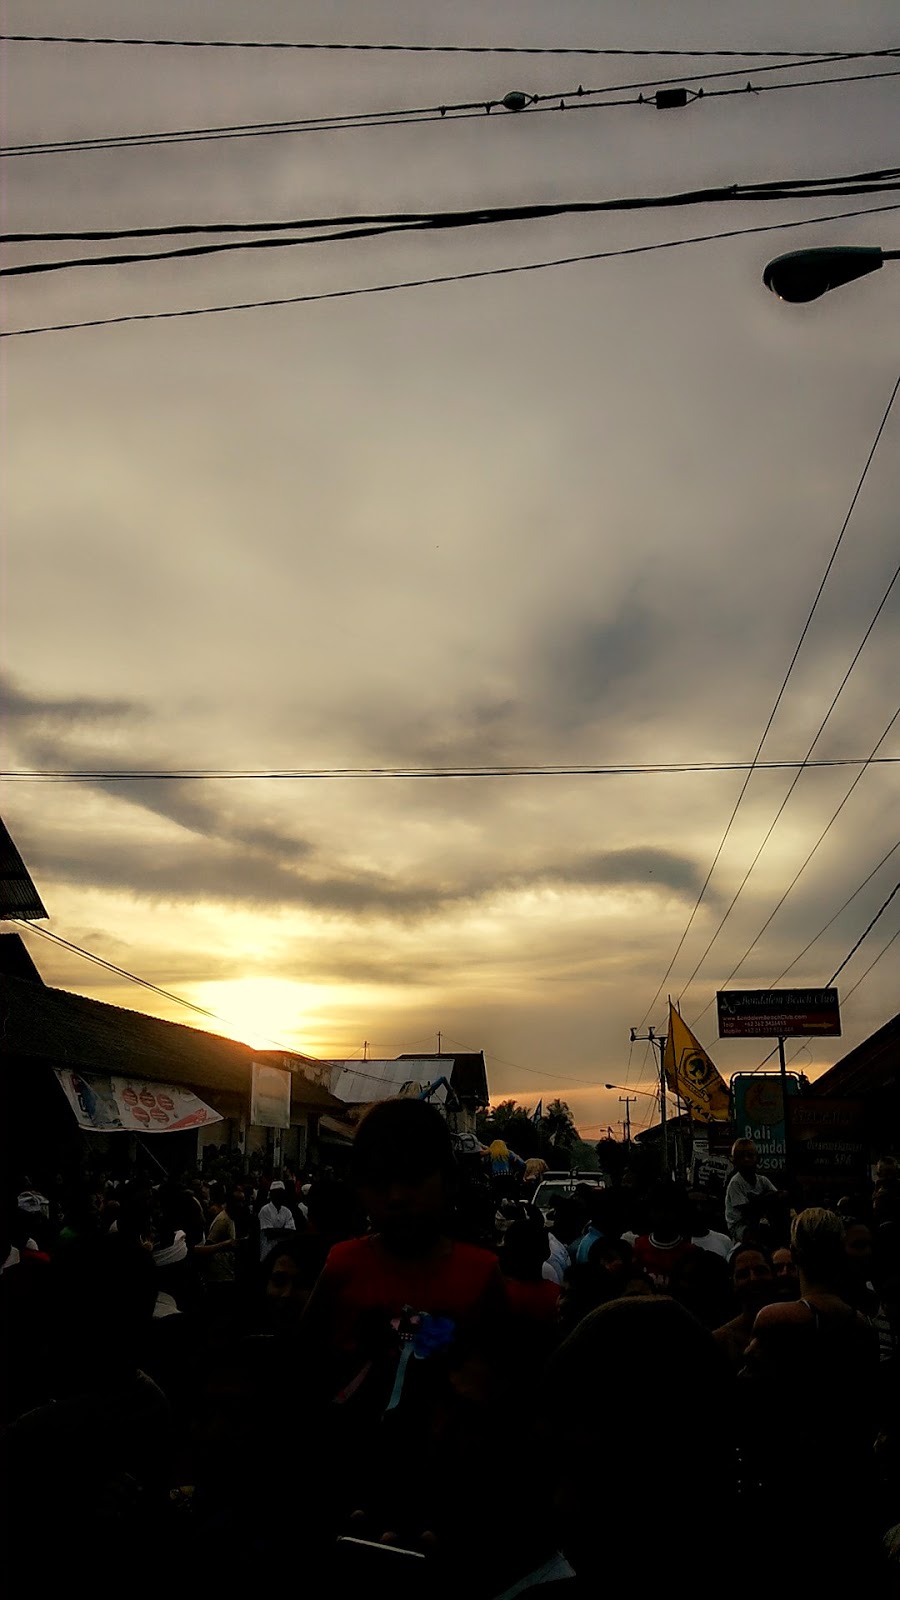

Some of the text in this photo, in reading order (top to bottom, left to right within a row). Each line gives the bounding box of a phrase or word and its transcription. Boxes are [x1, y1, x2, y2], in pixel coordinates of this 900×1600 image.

[741, 992, 836, 1006] Bondalem Beach Club
[744, 1125, 771, 1140] Bali
[756, 1139, 787, 1154] andal
[755, 1157, 786, 1170] sor
